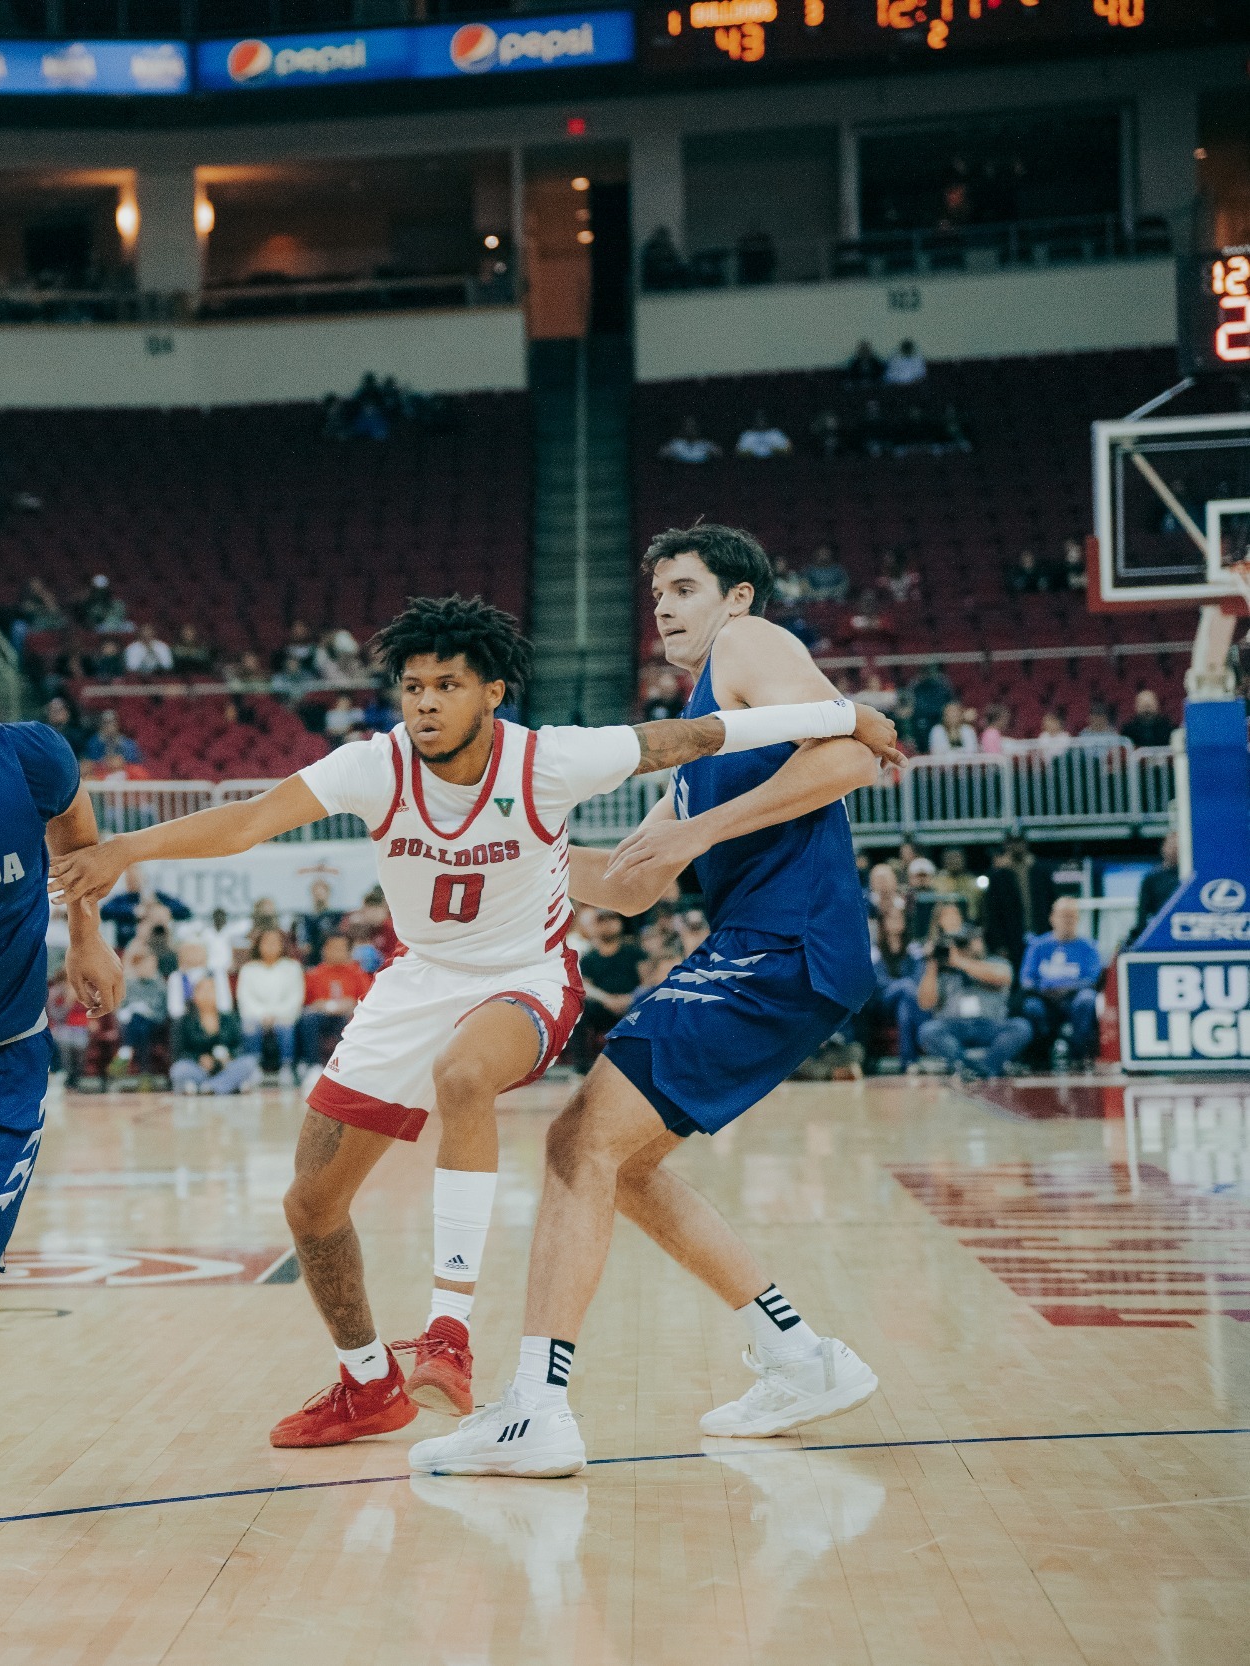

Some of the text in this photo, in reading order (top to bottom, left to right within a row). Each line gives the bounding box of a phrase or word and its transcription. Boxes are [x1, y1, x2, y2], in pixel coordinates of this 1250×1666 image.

[275, 38, 367, 76] pepsi
[499, 23, 594, 66] pepsi
[715, 22, 765, 62] 43
[387, 837, 521, 867] BULLDOGS
[429, 872, 486, 923] 0
[1157, 964, 1250, 1012] BU
[1132, 1007, 1250, 1058] LIG
